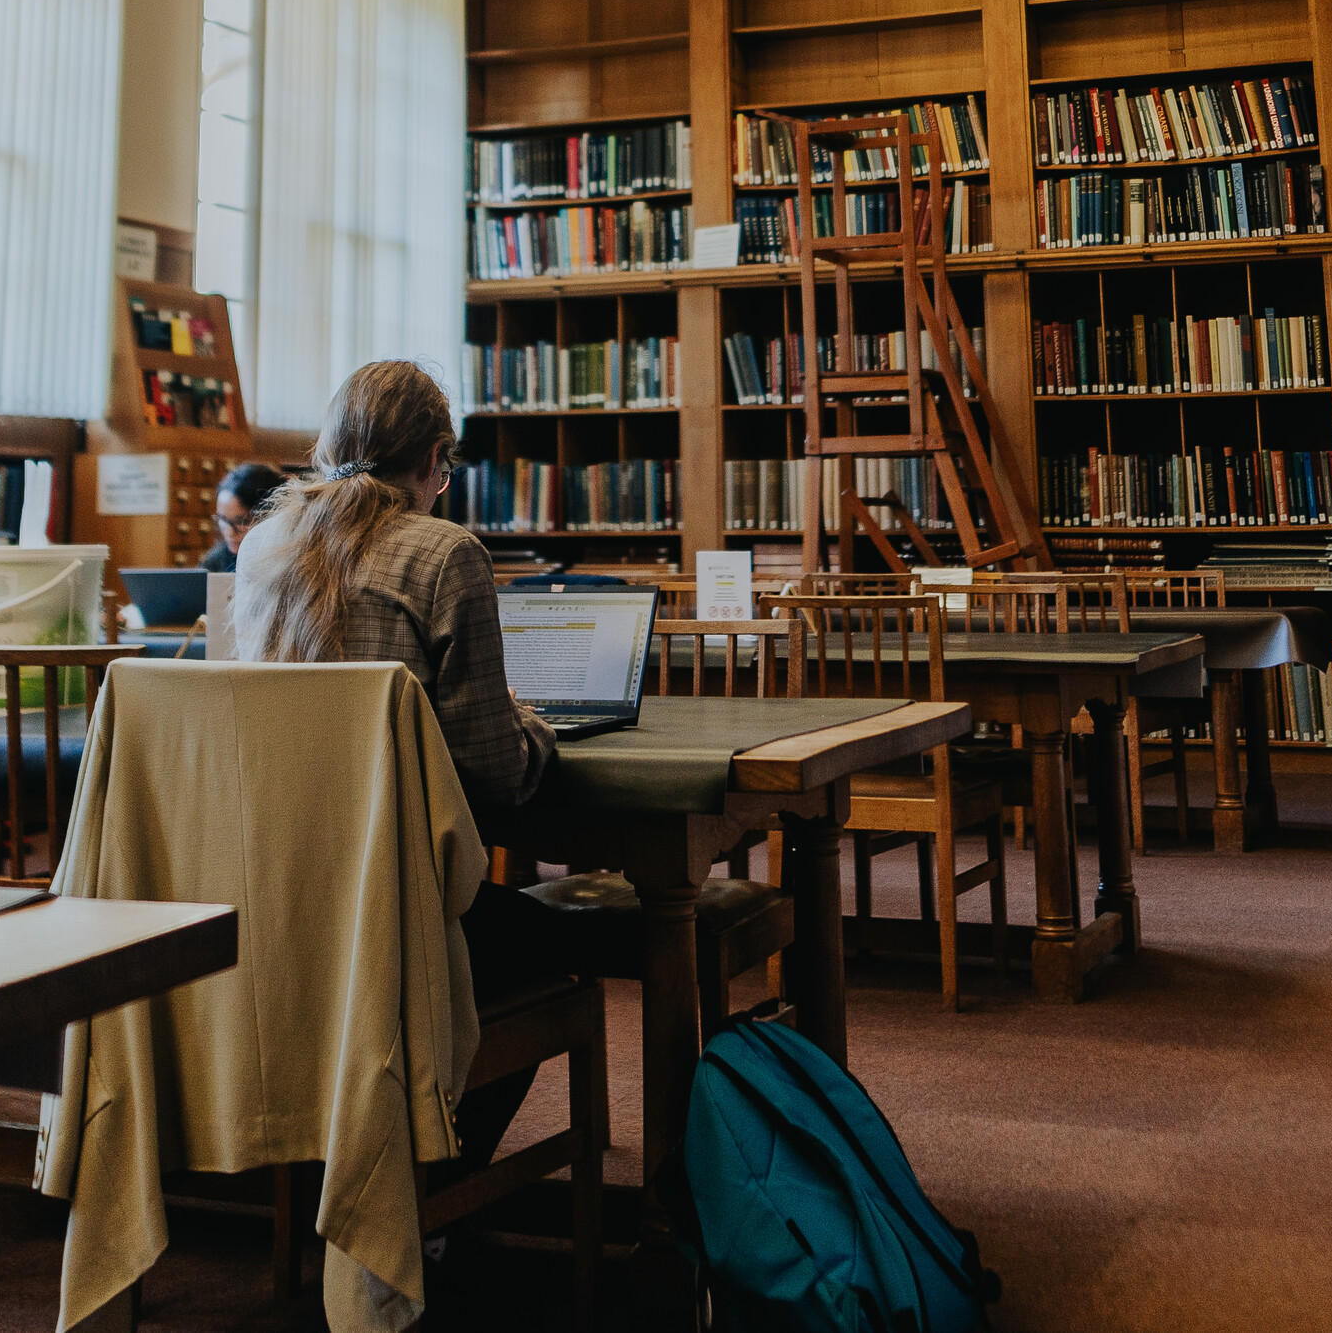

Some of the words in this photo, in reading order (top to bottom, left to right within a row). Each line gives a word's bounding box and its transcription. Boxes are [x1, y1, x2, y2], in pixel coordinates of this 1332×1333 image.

[1264, 88, 1276, 114] UNKNOWN
[1100, 104, 1112, 146] CARAVAGGIO
[1156, 105, 1171, 140] CIMABUE
[1205, 463, 1215, 512] REMBRANDT
